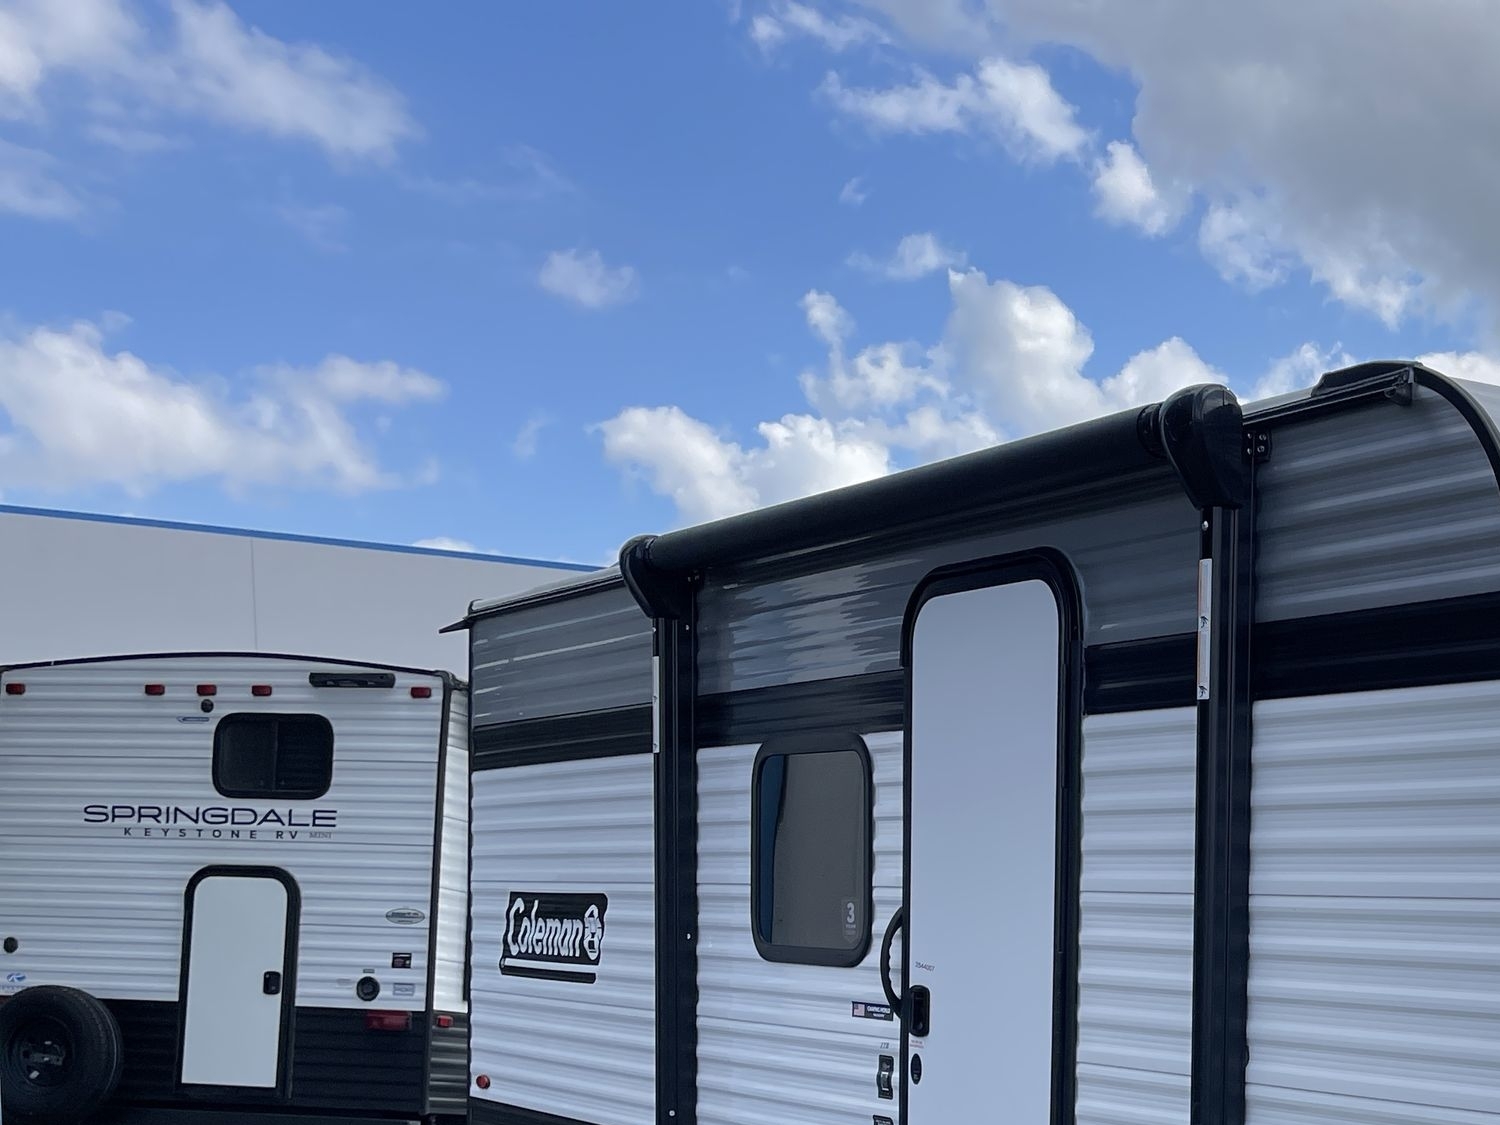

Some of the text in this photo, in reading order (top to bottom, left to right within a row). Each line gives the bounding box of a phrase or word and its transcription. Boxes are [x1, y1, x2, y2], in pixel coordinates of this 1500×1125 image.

[84, 804, 337, 828] SPRINGDALE
[124, 827, 257, 839] KEYSTONE
[276, 830, 299, 840] RV
[846, 902, 855, 923] 3
[507, 897, 583, 957] Coleman
